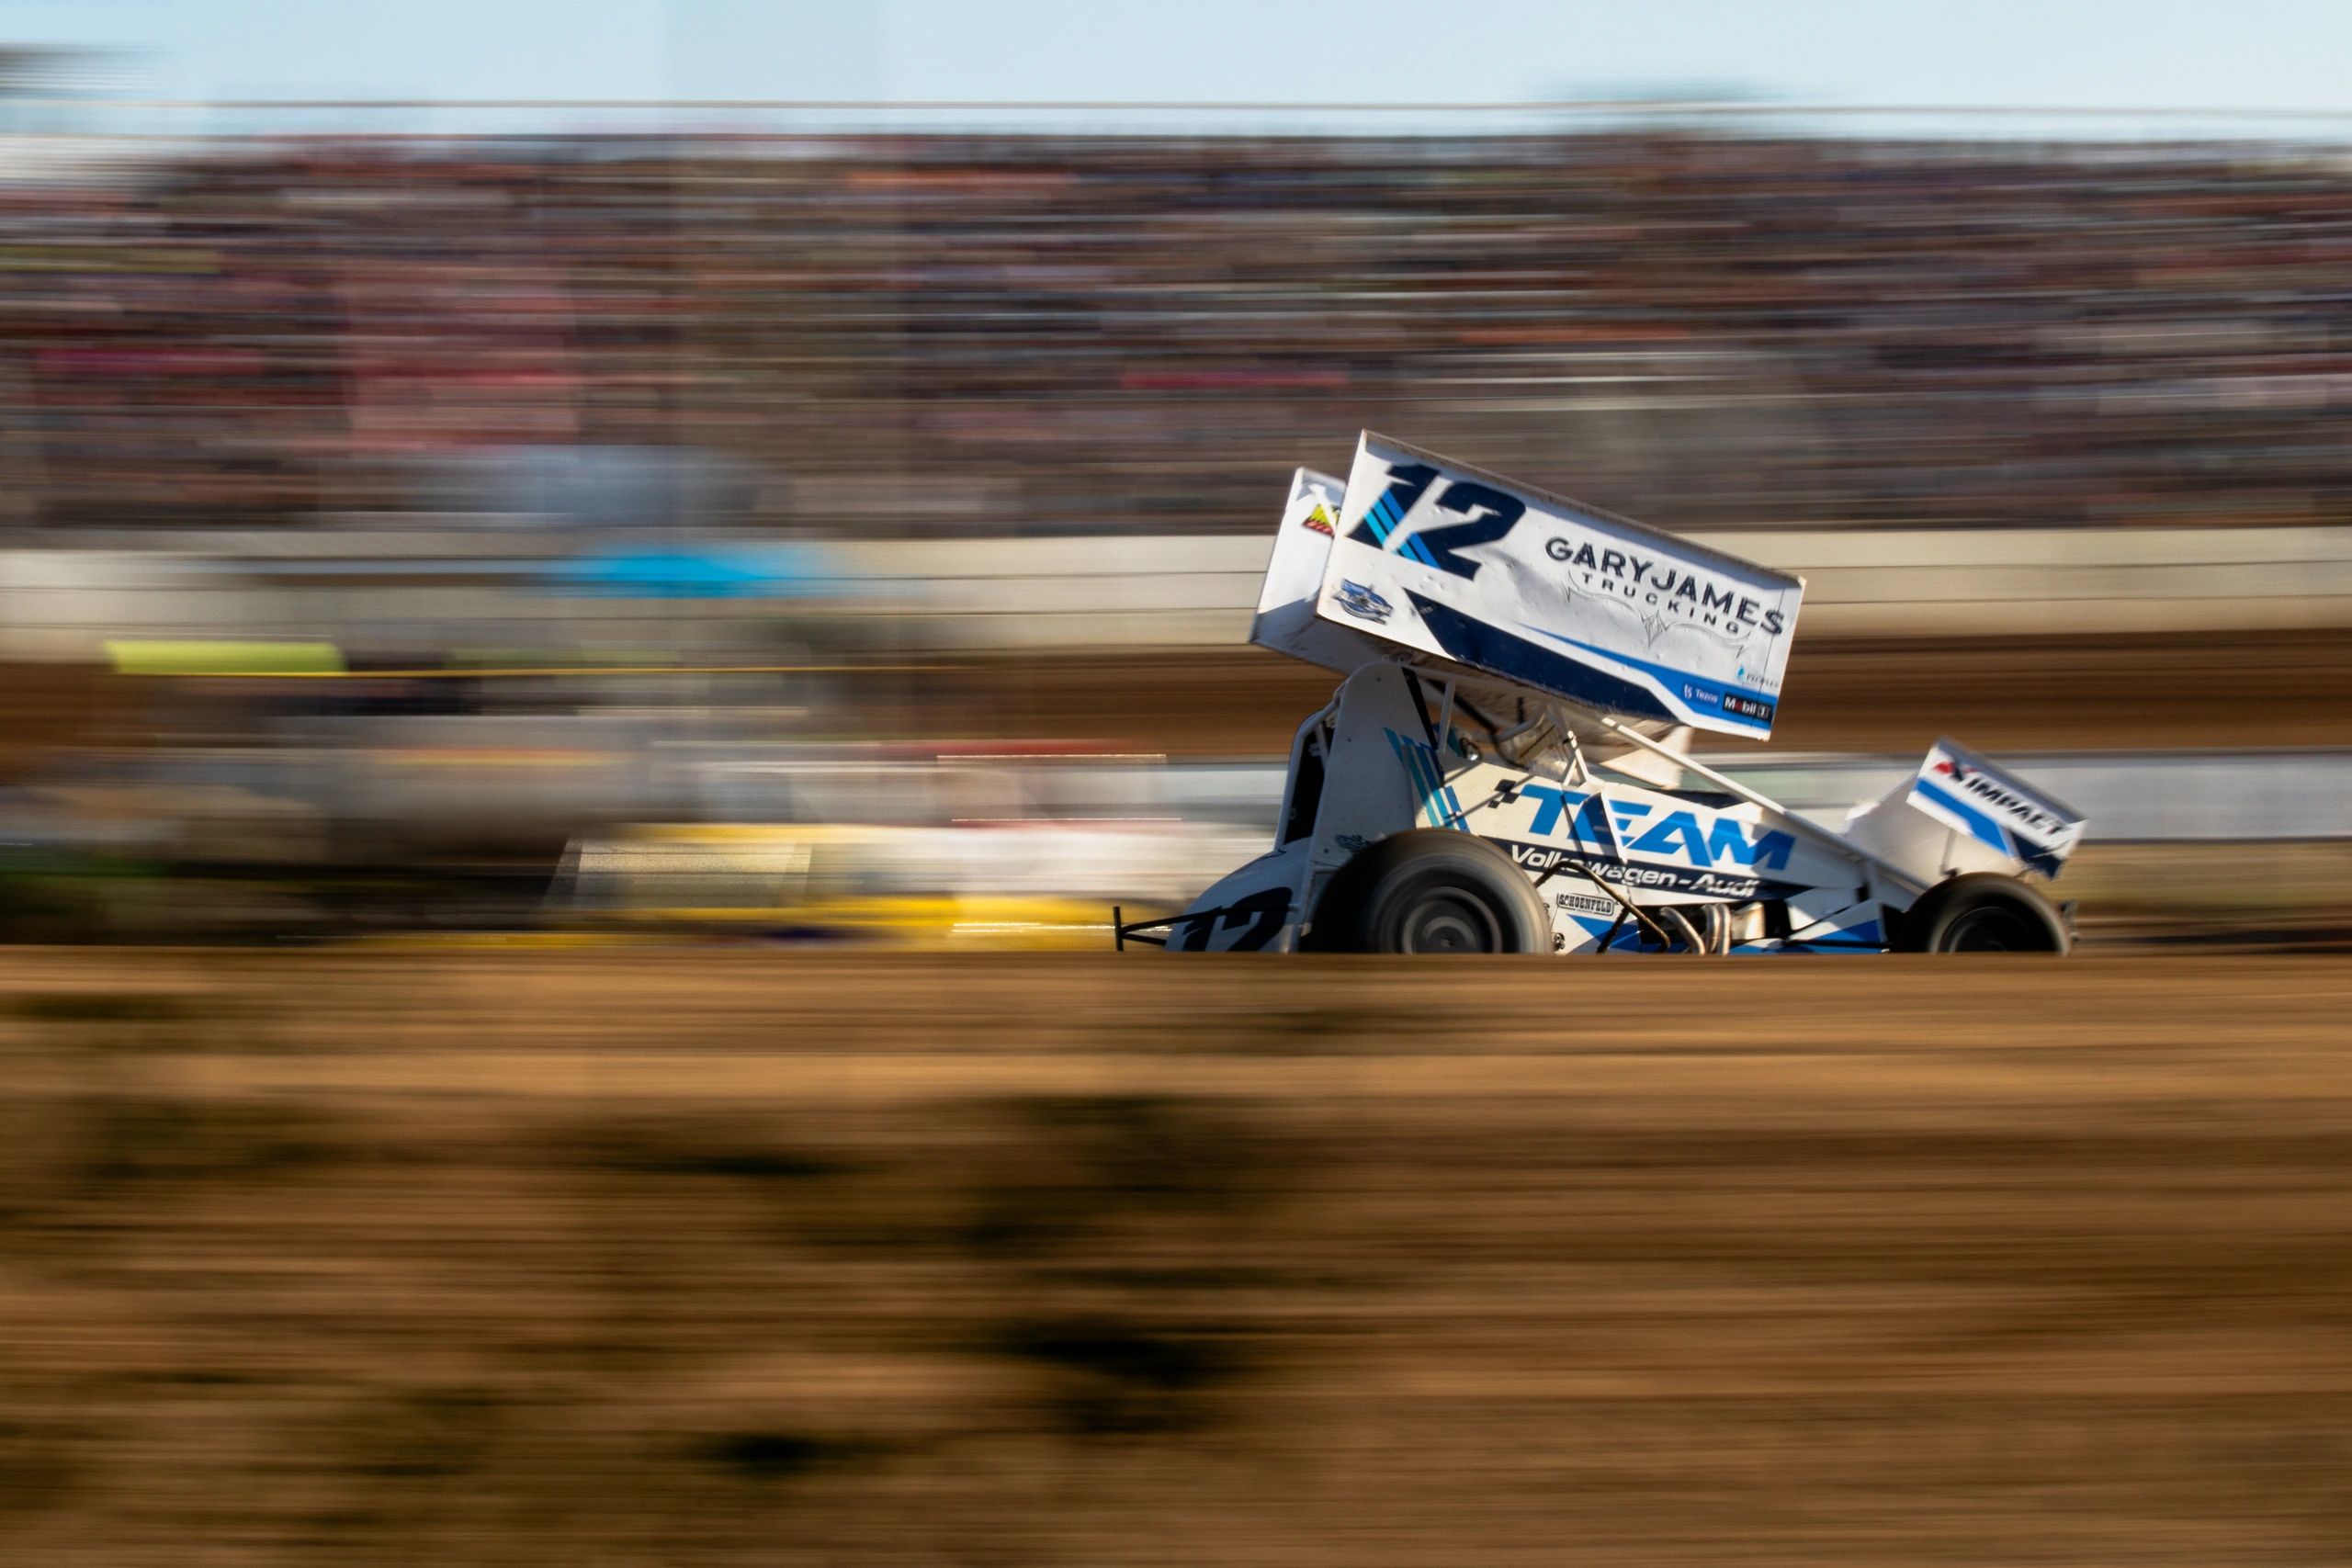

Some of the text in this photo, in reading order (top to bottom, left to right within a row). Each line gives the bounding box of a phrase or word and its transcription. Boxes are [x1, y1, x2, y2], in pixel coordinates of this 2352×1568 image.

[1344, 463, 1526, 581] 12
[1581, 571, 1740, 635] TRUCKING
[1724, 695, 1757, 716] Mobil
[1520, 784, 1796, 871] TEAM
[1963, 774, 2072, 837] IMPACT
[1558, 893, 1612, 914] SCHOENFELD
